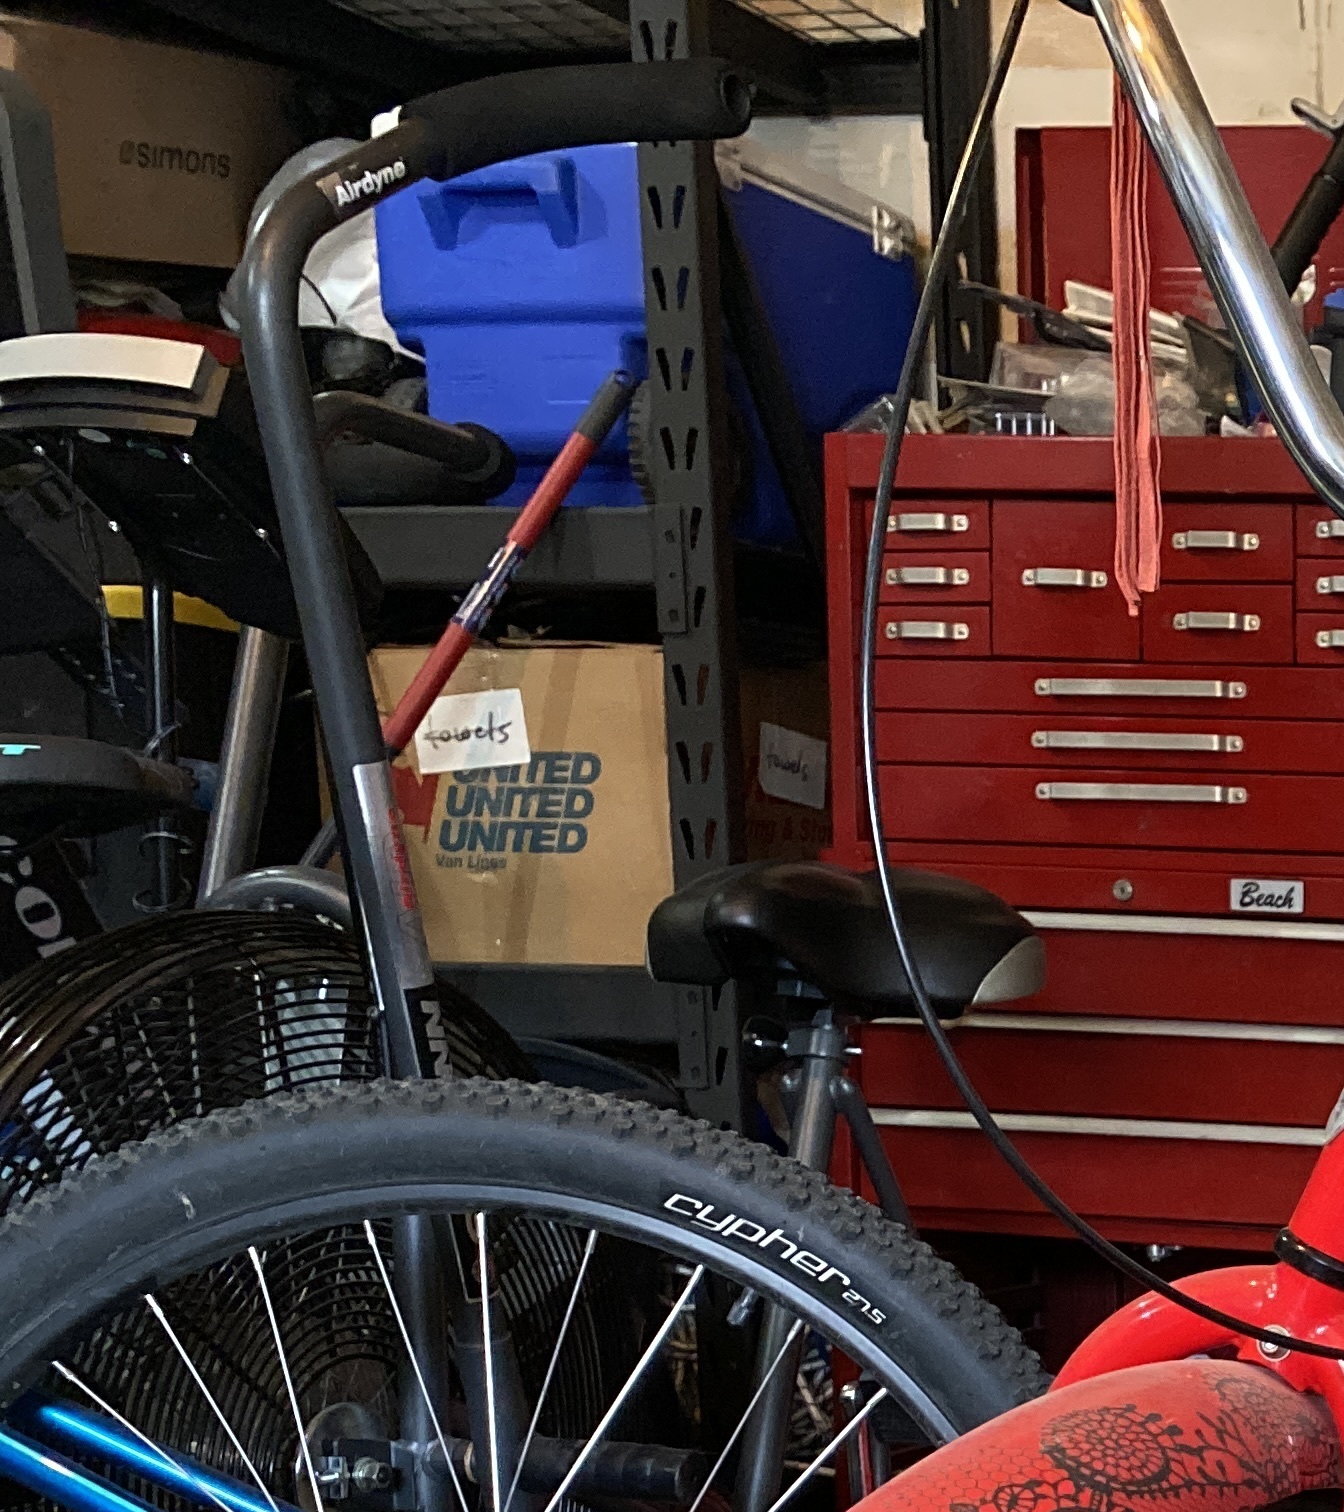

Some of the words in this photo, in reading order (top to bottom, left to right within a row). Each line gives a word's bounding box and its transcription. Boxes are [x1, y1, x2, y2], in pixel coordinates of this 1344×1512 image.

[334, 160, 406, 207] Airdyne
[446, 785, 595, 819] UNITED
[439, 819, 588, 854] UNITED
[434, 853, 463, 868] Van
[1240, 882, 1295, 909] Beach
[664, 1193, 851, 1286] cypher
